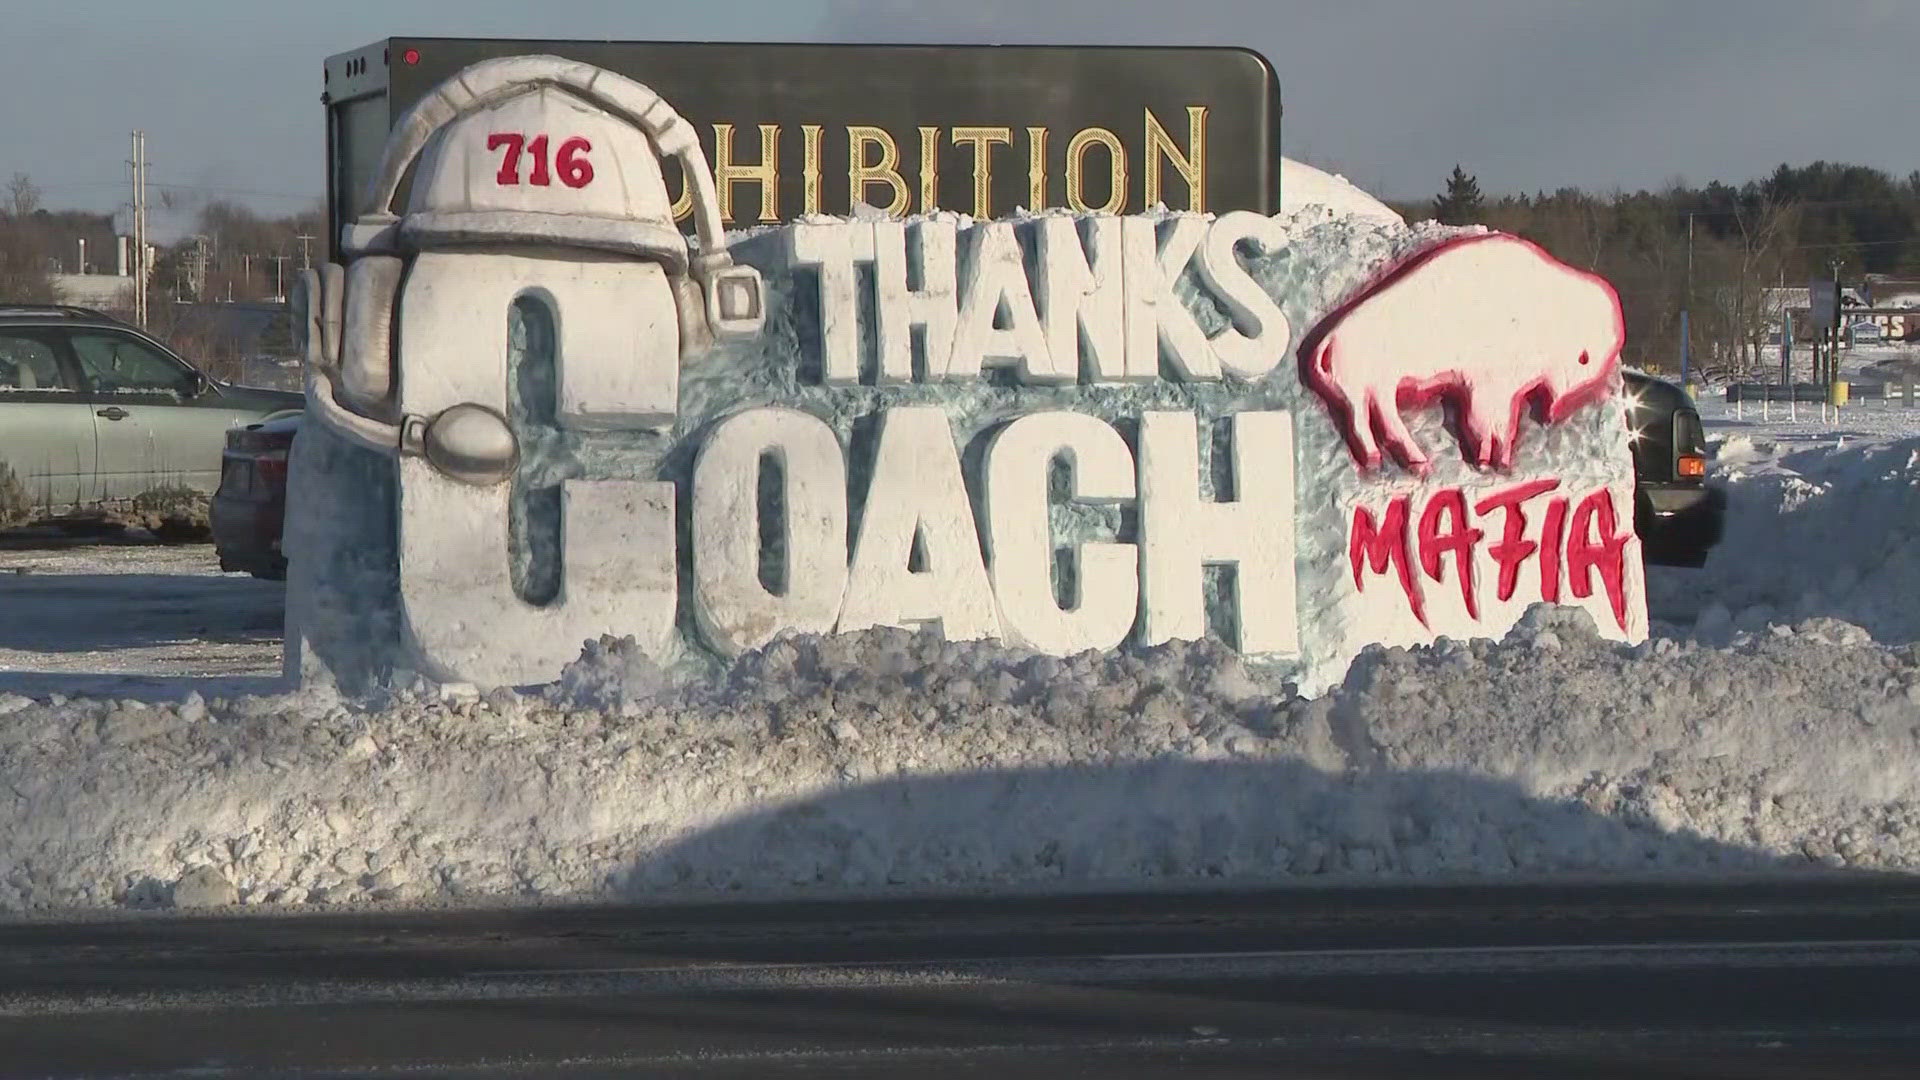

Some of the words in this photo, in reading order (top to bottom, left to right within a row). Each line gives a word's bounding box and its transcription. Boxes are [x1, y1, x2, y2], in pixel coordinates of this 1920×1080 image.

[488, 134, 594, 188] 716
[671, 106, 1209, 223] HIBITION
[793, 210, 1291, 383] THANKS
[400, 252, 1299, 688] COACH
[1349, 479, 1632, 633] MAFIA
